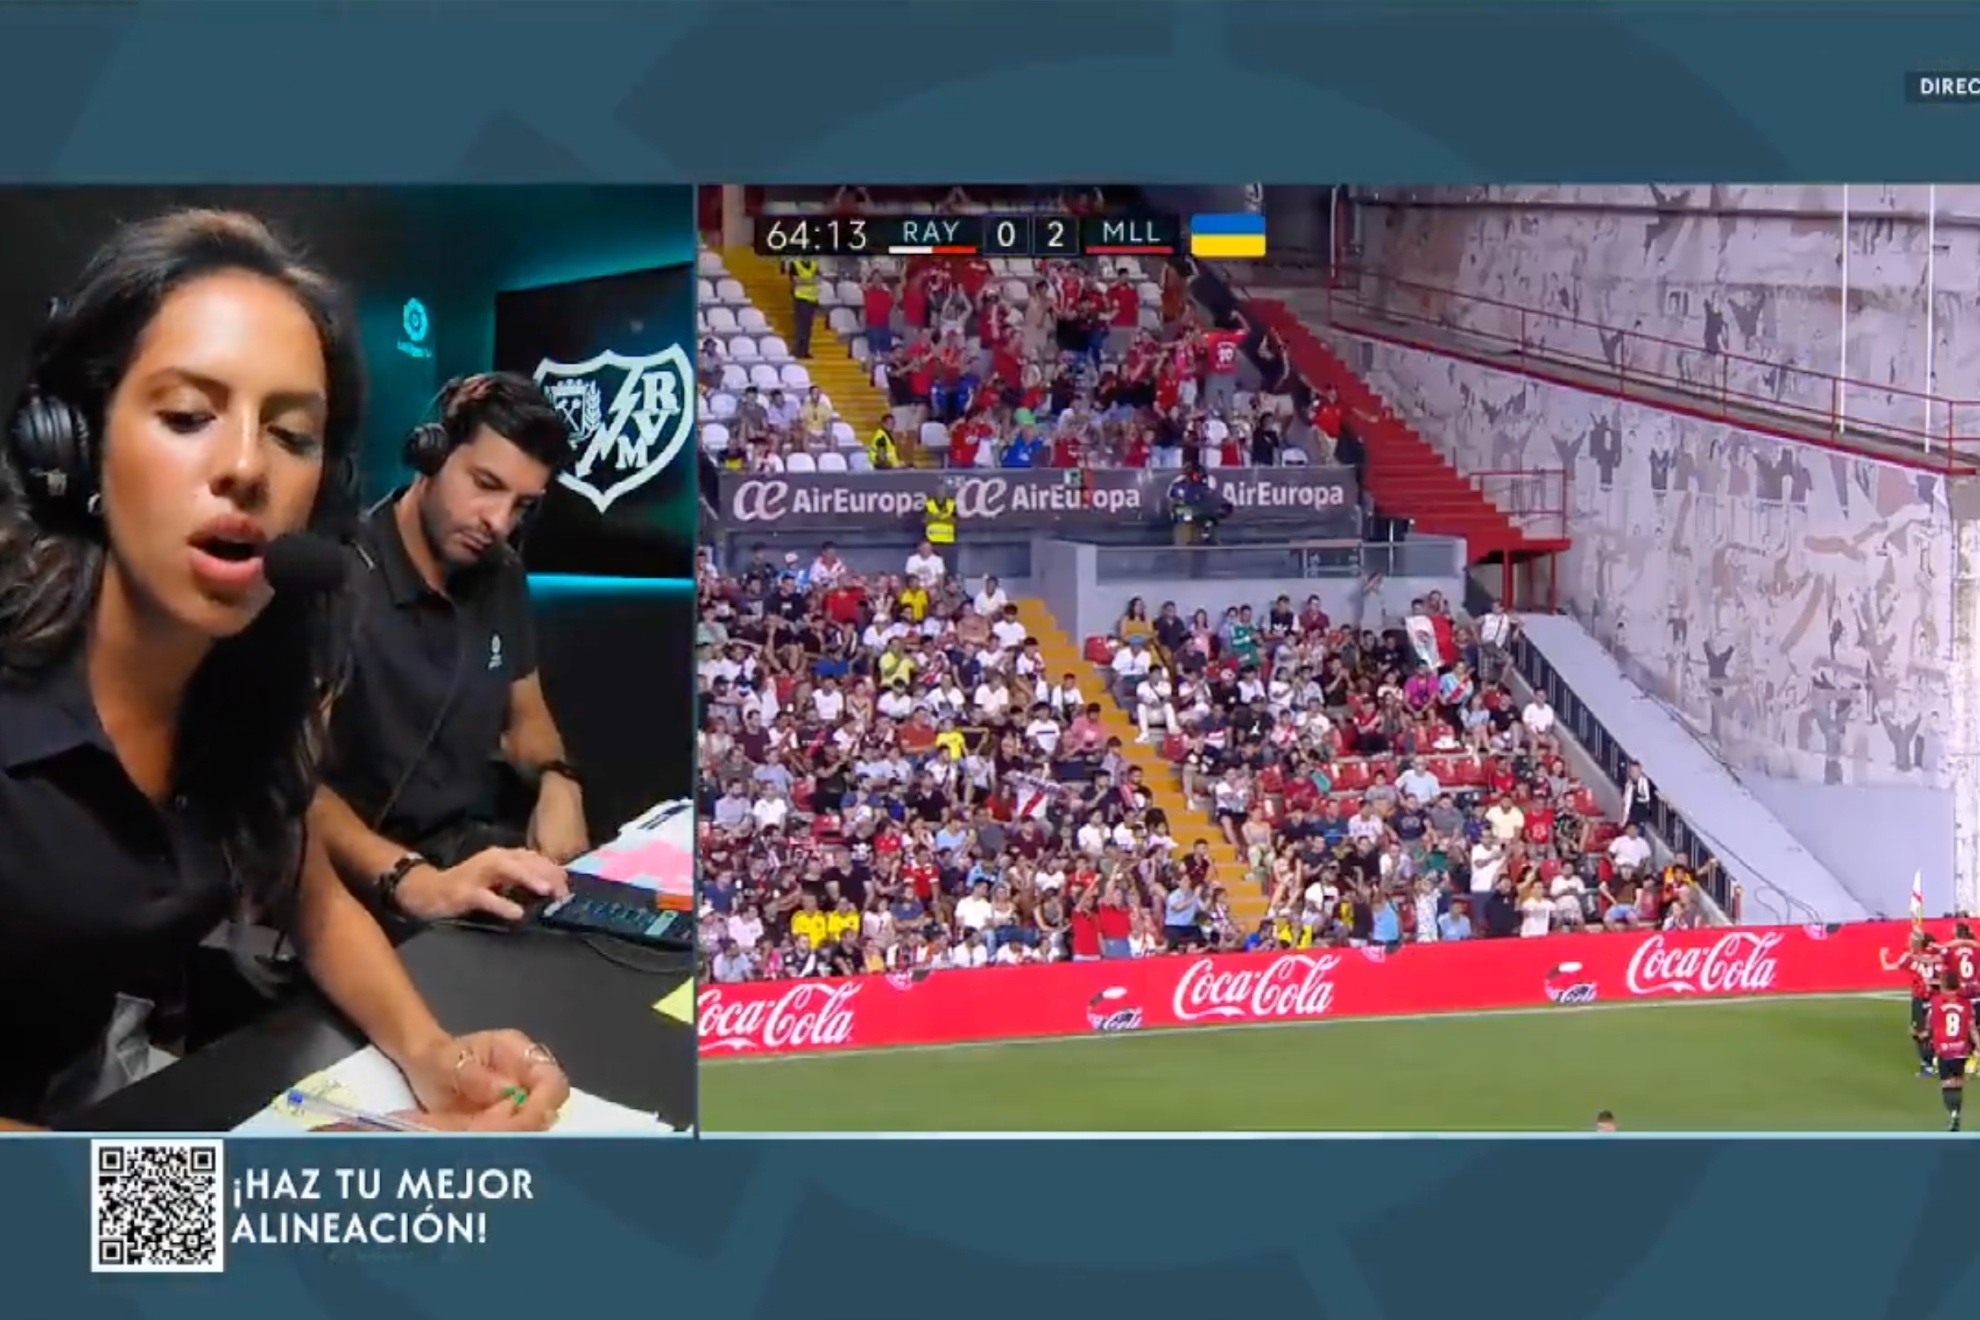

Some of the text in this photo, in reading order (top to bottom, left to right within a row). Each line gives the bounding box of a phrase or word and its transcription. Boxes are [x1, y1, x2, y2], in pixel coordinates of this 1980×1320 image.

[792, 487, 928, 517] AirEuropa
[1011, 483, 1141, 513] AirEuopa
[1222, 481, 1344, 512] AirEuropa
[1959, 954, 1974, 979] 6
[1945, 1011, 1961, 1038] 8
